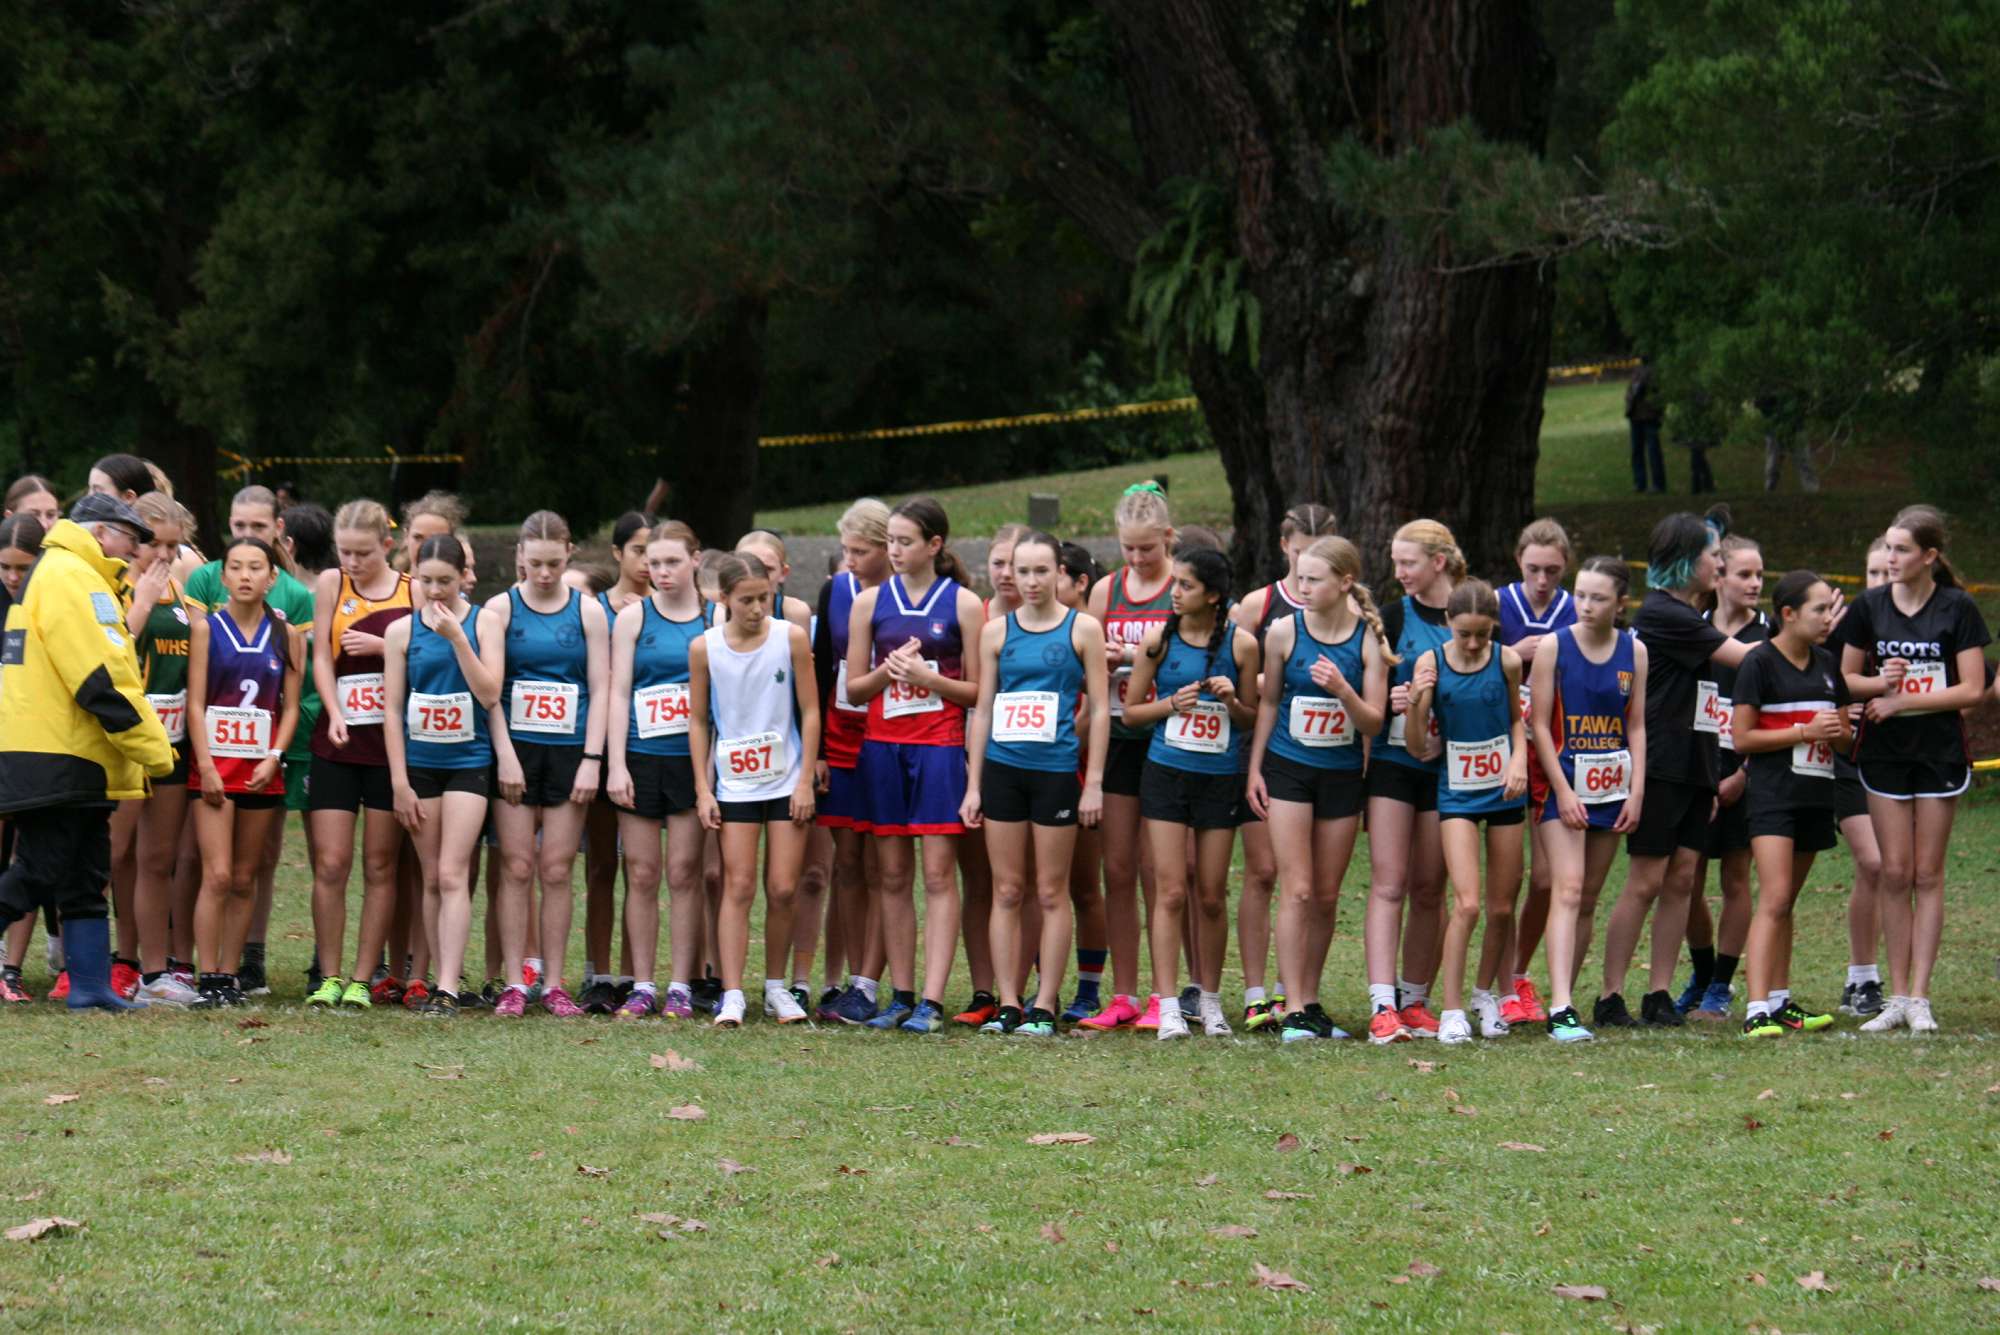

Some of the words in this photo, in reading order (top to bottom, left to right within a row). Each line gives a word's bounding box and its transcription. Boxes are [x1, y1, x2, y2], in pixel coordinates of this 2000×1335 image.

[155, 638, 190, 656] WHS
[1876, 640, 1941, 657] SCOTS
[239, 679, 259, 708] 2
[346, 687, 385, 711] 453
[514, 682, 559, 692] Temporary
[418, 705, 463, 731] 752
[523, 694, 566, 721] 753
[645, 695, 690, 724] 754
[1004, 704, 1046, 729] 755
[214, 719, 259, 746] 511
[1178, 712, 1221, 740] 759
[1302, 709, 1346, 735] 772
[1567, 715, 1624, 736] TAWA
[1450, 742, 1493, 752] Temporary
[1567, 736, 1622, 750] COLLEGE
[729, 744, 773, 774] 567
[1458, 750, 1503, 779] 750
[1586, 764, 1624, 792] 664
